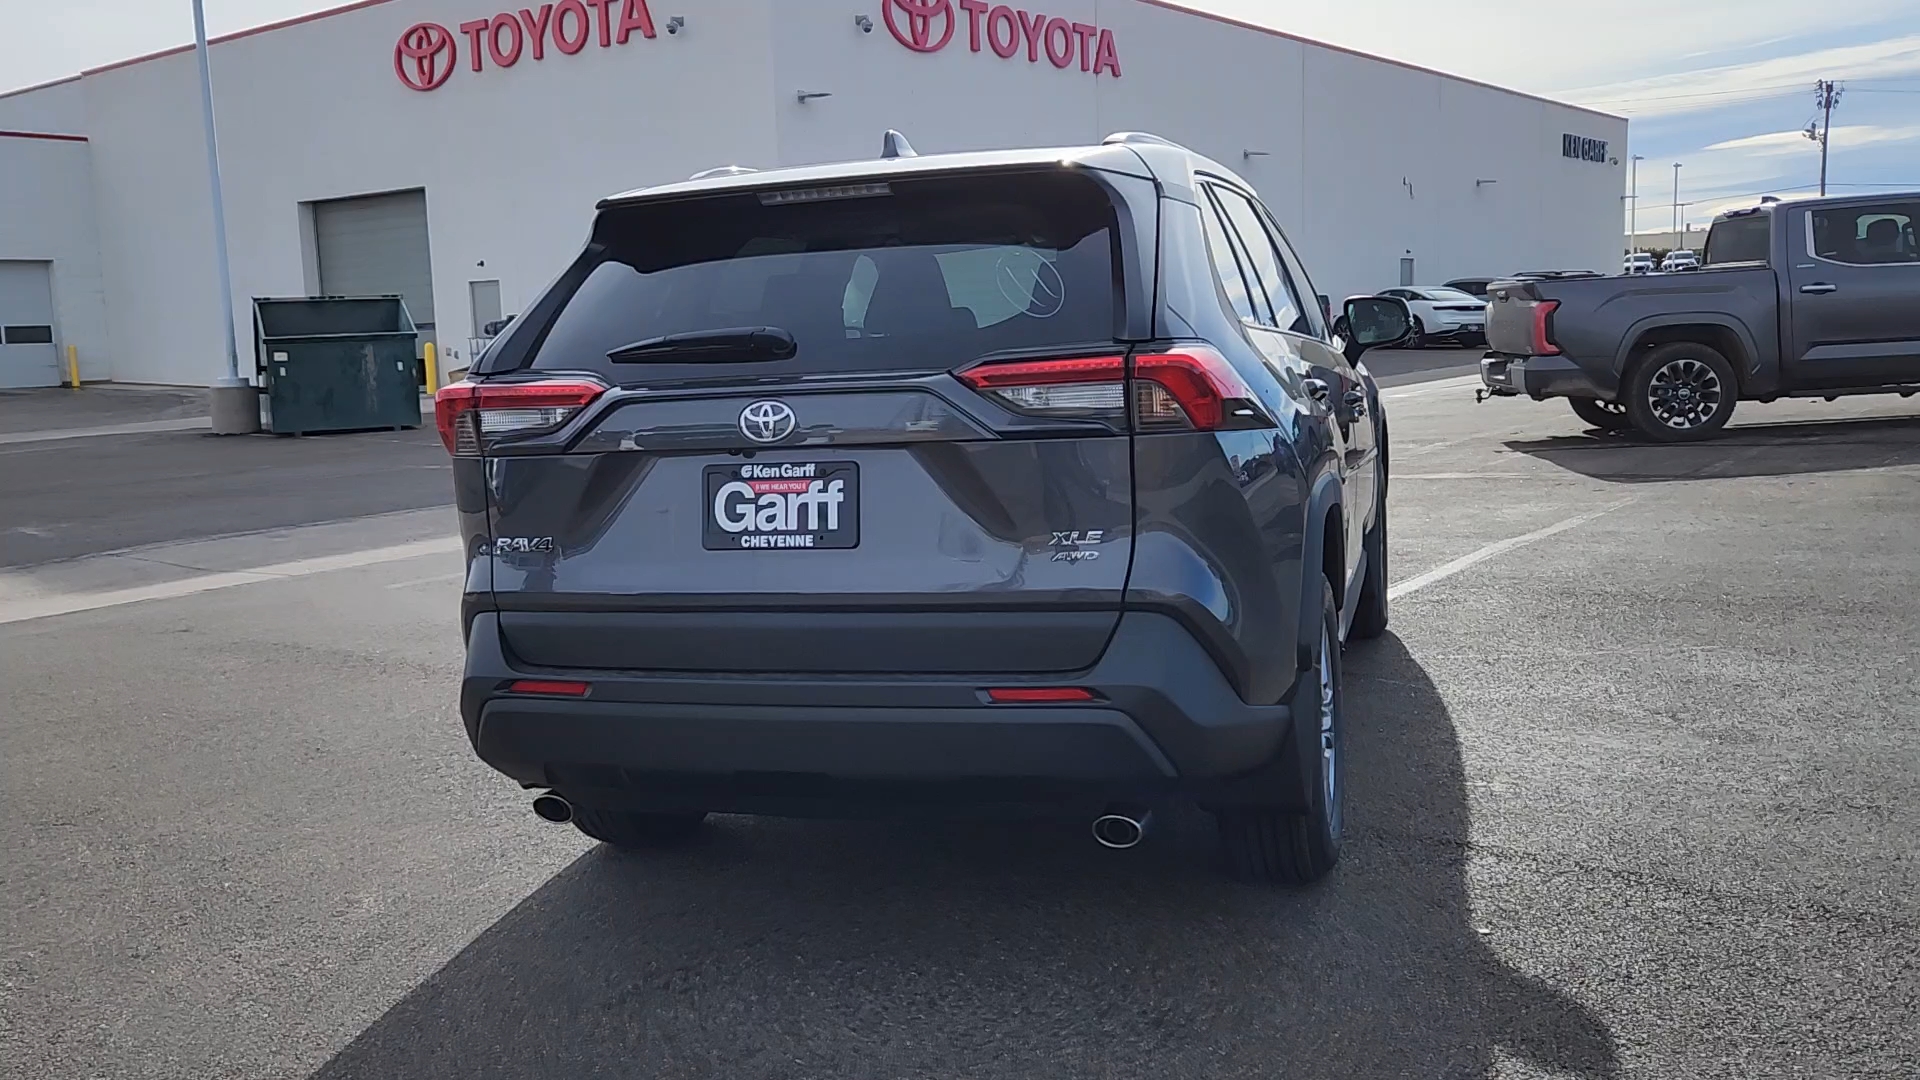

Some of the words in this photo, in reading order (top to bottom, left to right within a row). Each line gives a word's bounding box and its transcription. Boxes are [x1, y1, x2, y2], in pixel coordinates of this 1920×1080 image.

[460, 0, 657, 72] TOYOTA
[960, 0, 1122, 77] TOYOTA
[1563, 133, 1581, 159] KEN
[753, 464, 780, 478] Ken
[781, 463, 816, 478] Garff
[789, 482, 802, 490] YOU
[714, 479, 844, 533] Garff
[496, 536, 553, 552] RAV4
[740, 534, 814, 548] CHEYENNE
[1048, 530, 1104, 546] XLE
[1051, 550, 1099, 562] AWD
